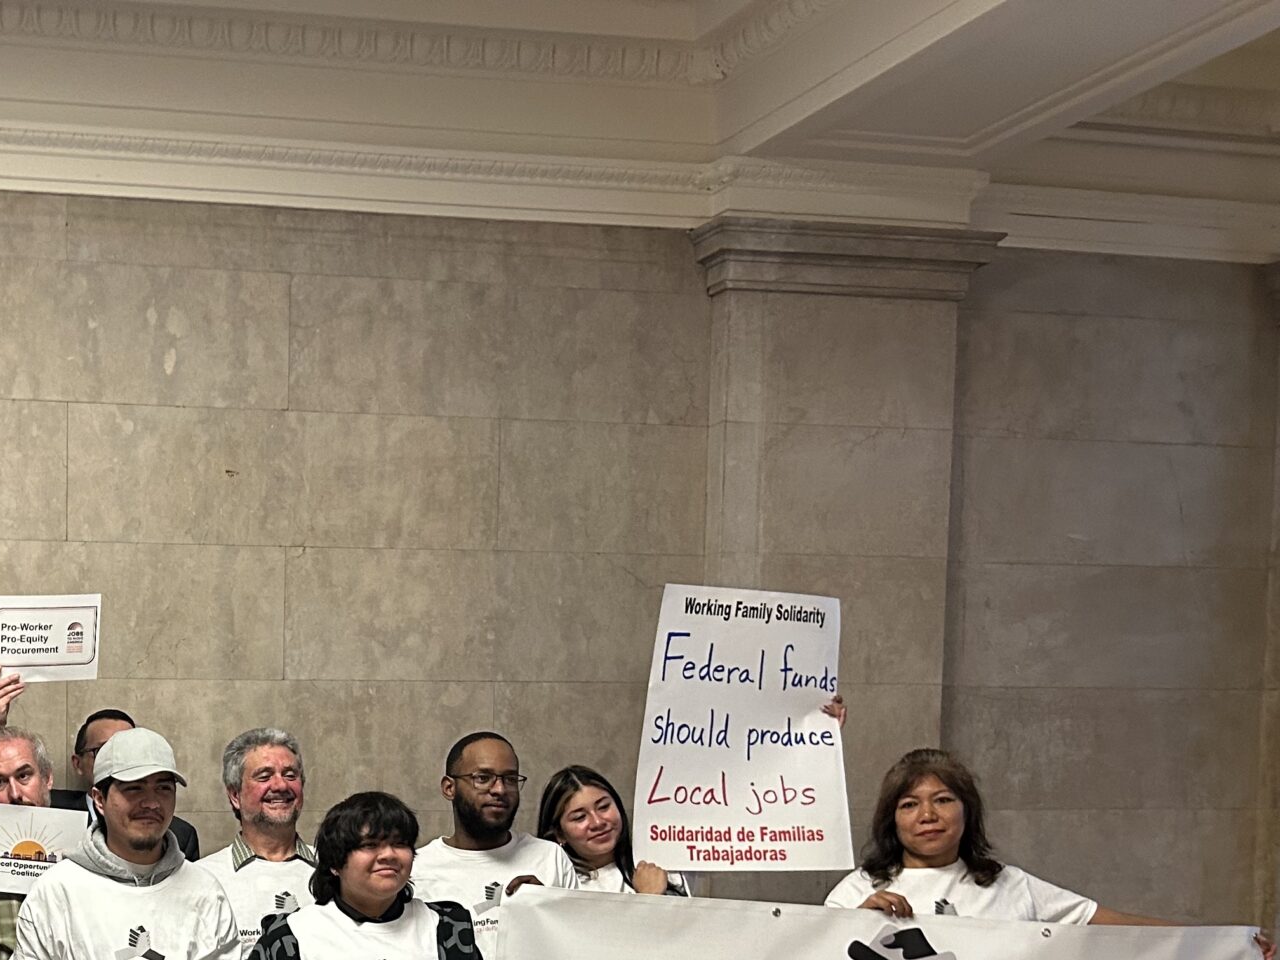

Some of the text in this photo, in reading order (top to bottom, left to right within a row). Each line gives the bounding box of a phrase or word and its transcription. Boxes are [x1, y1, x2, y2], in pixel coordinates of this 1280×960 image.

[685, 597, 825, 628] Working Family Solidarity
[1, 623, 52, 631] Pro-Worker
[1, 635, 48, 644] Pro-Equity
[1, 646, 58, 654] Procurement
[662, 632, 837, 692] Federal funds
[747, 717, 834, 760] produce
[647, 766, 815, 815] Local jobs
[650, 825, 824, 842] Solidaridad de Familias
[687, 845, 787, 865] Trabajadoras
[239, 928, 261, 936] Work
